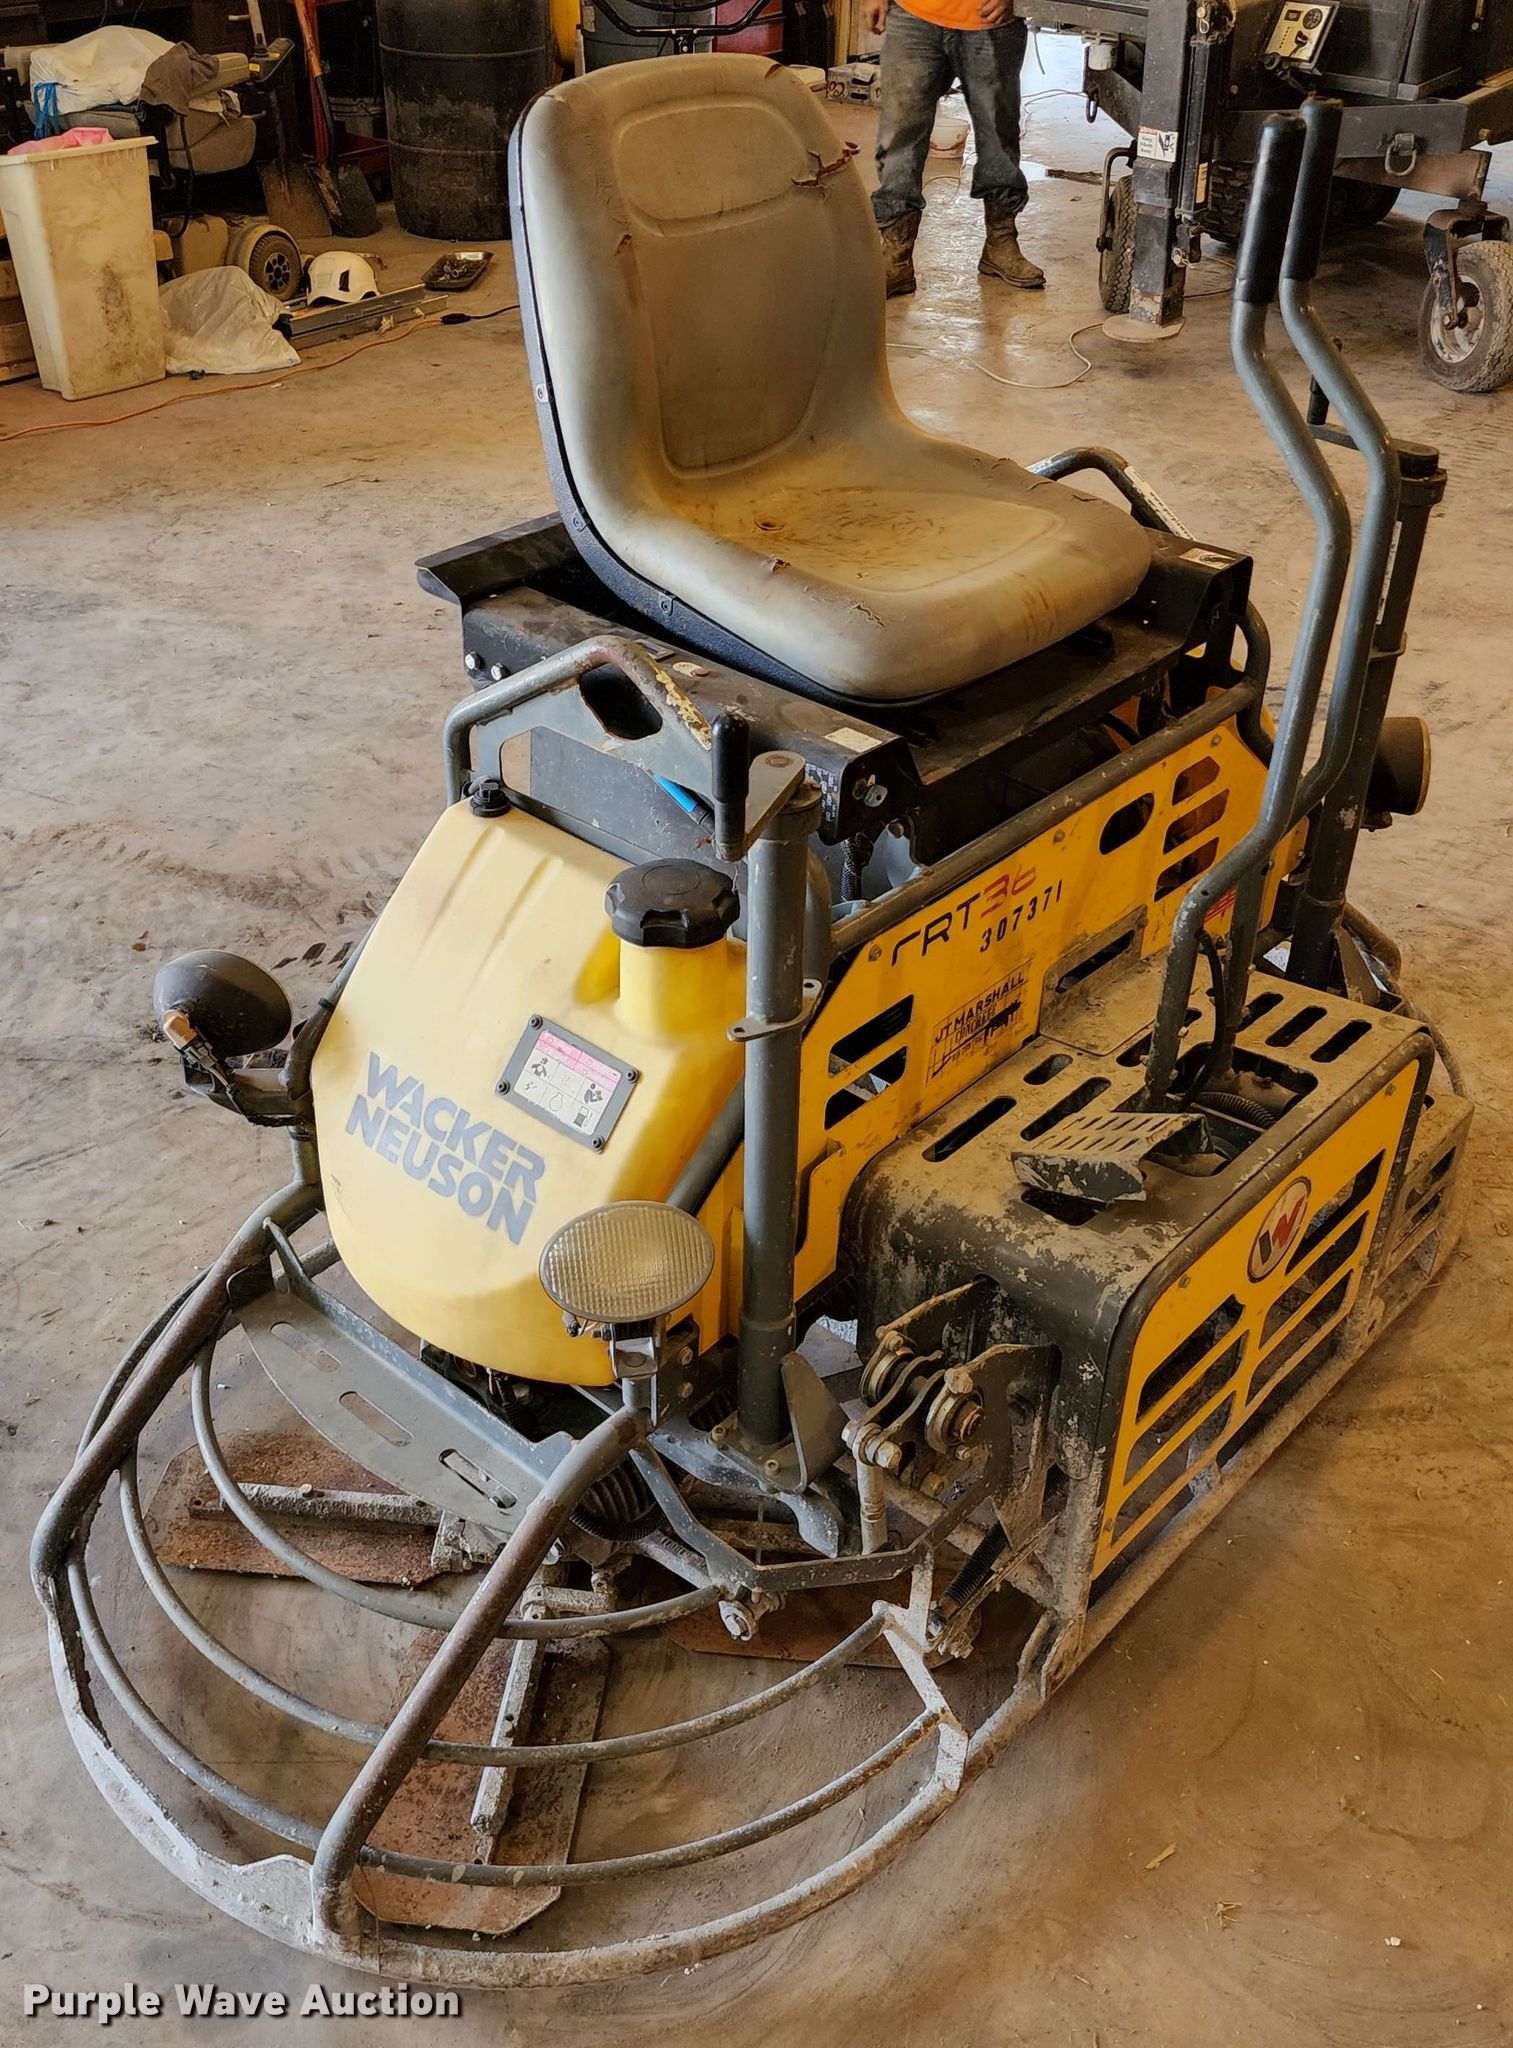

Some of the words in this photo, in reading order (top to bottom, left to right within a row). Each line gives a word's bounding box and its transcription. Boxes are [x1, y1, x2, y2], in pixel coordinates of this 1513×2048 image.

[980, 879, 1062, 953] 307371
[954, 972, 1025, 1031] MARSHALL
[344, 1094, 535, 1246] NEUSON
[366, 1051, 546, 1203] WACKER
